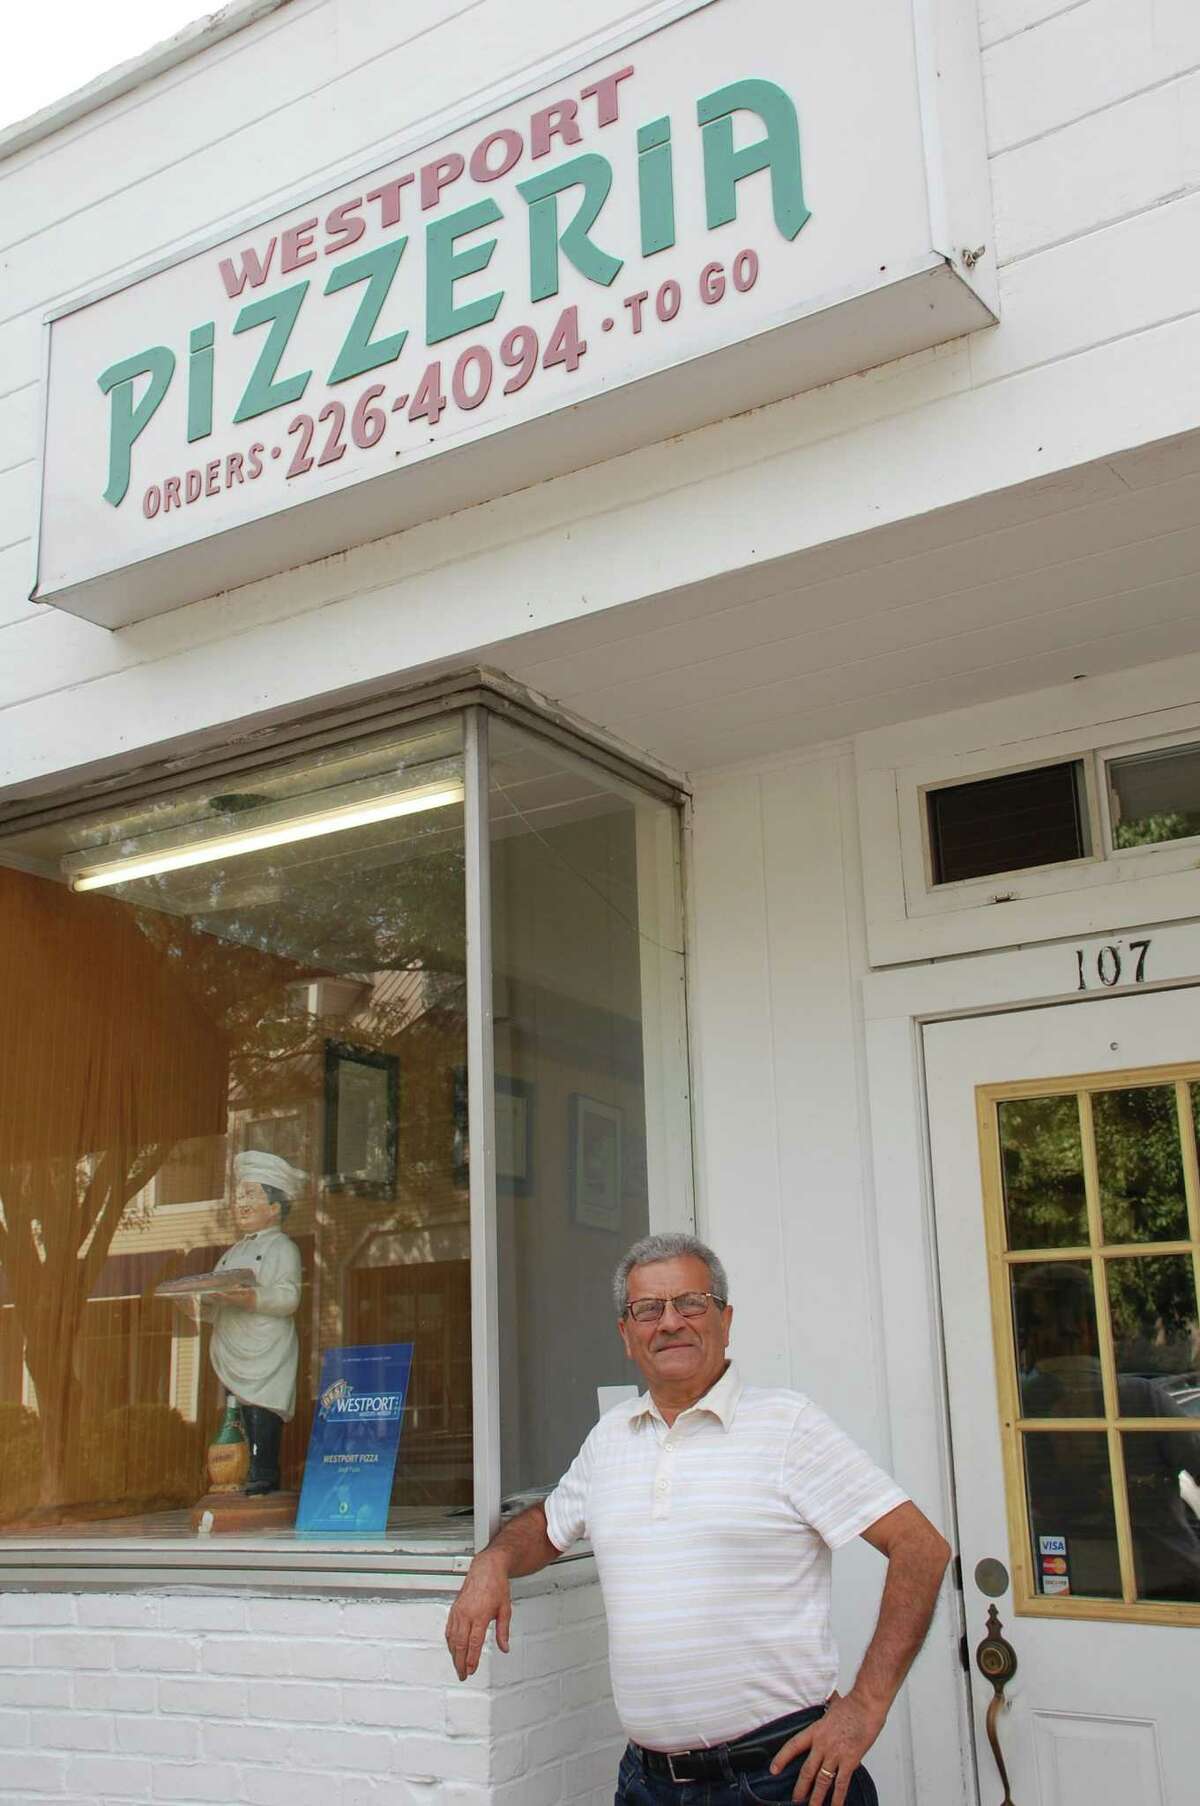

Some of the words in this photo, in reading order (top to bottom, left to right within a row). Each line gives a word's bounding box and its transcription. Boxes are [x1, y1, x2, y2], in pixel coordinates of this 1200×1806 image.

[217, 64, 635, 299] WESTPORT
[143, 442, 265, 519] ORDERS
[285, 303, 588, 480] 226-4094
[623, 279, 682, 335] TO
[699, 248, 760, 305] GO
[1076, 939, 1152, 991] 107
[337, 1396, 396, 1413] WESTPORT
[1042, 1541, 1065, 1551] VISA
